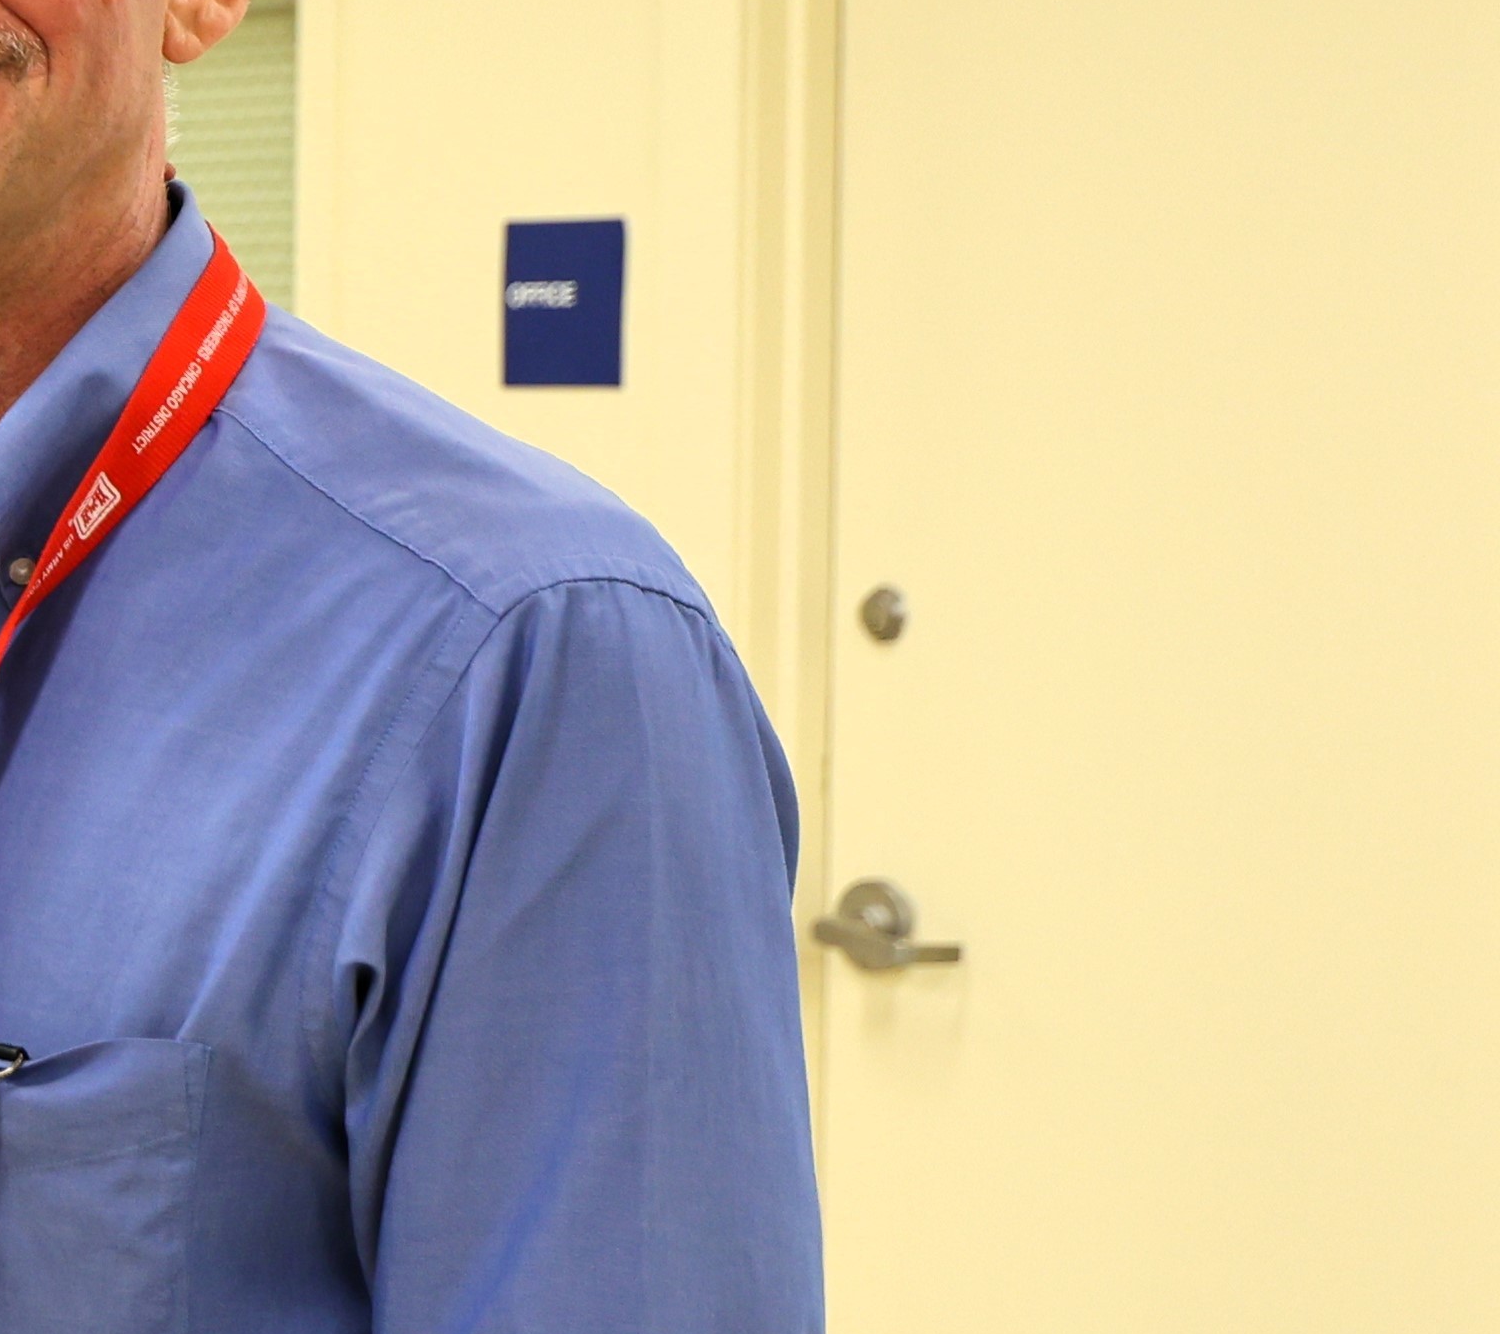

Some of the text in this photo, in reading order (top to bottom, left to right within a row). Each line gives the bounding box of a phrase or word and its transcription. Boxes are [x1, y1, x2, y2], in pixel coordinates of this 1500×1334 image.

[505, 280, 579, 310] OFFICE
[197, 310, 234, 361] ENGINEERS
[166, 361, 202, 409] CHICAGO
[132, 405, 172, 454] DISTRICT
